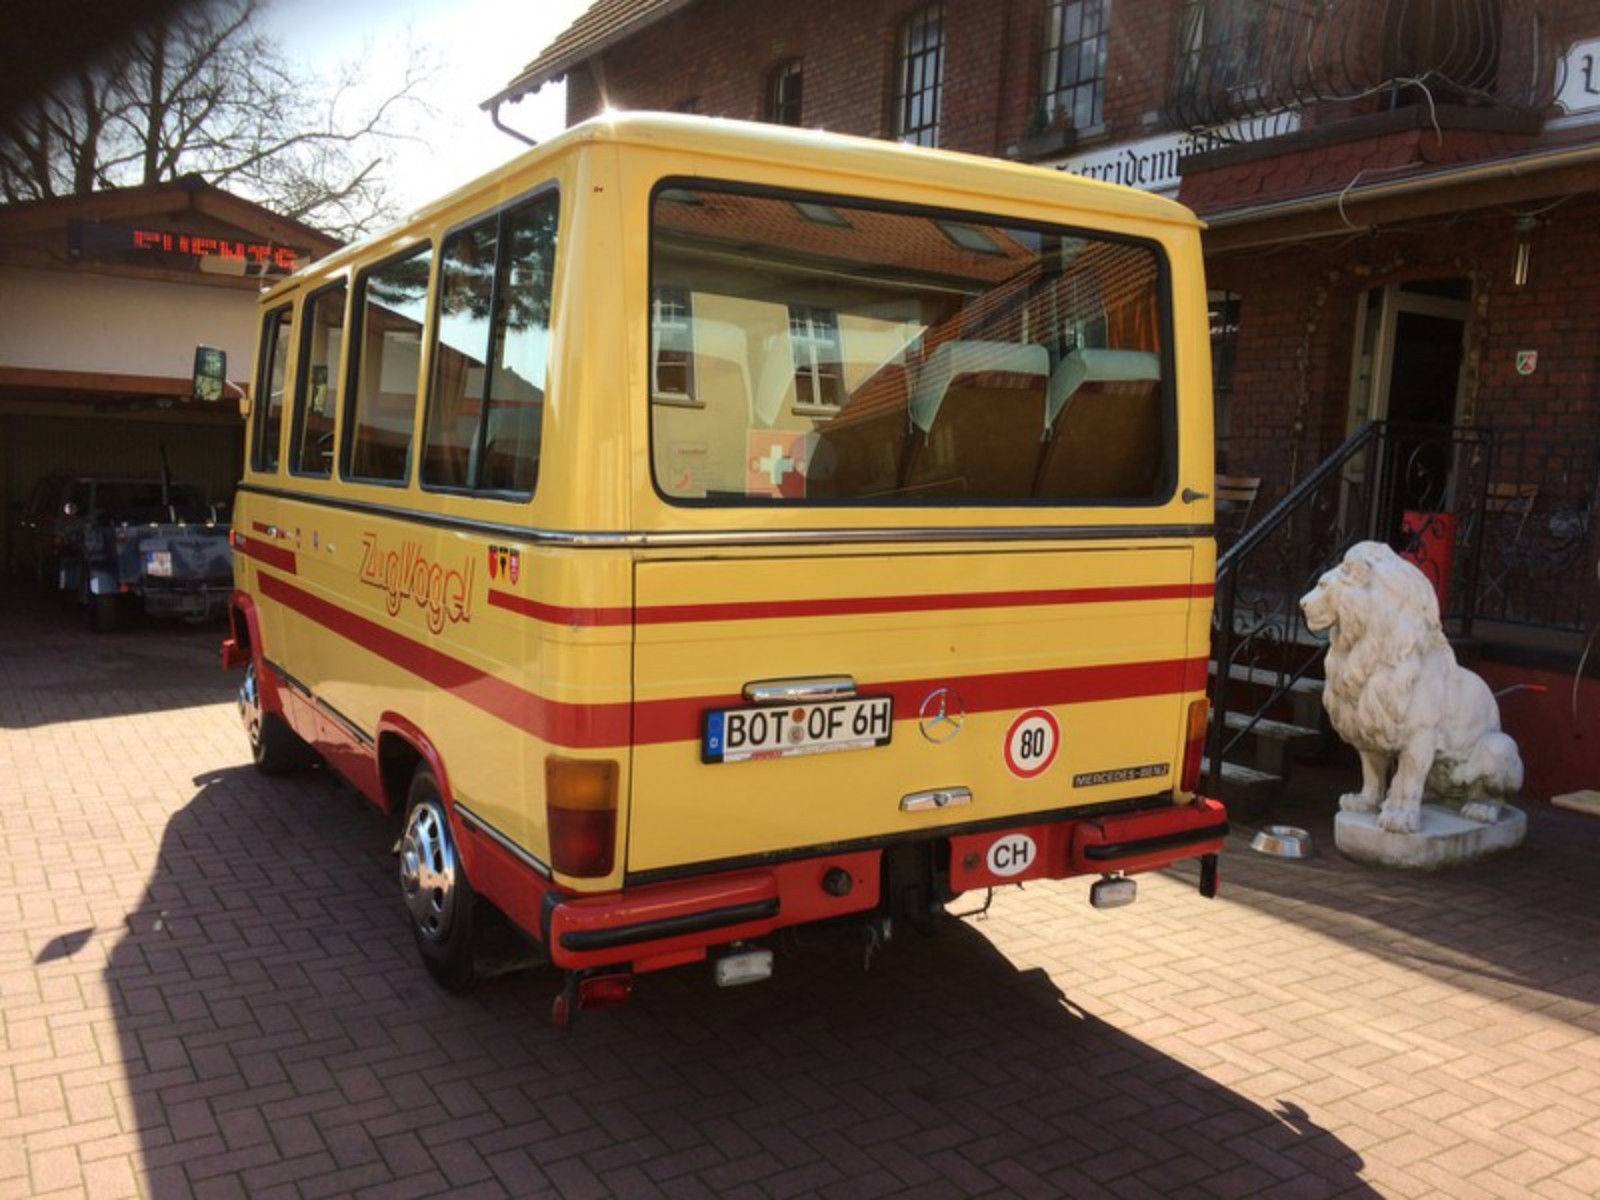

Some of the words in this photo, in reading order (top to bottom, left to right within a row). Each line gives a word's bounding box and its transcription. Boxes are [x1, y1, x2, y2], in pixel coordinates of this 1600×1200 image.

[727, 710, 789, 748] BOT
[807, 705, 846, 739] OF
[852, 701, 888, 736] 6H
[1020, 727, 1045, 759] 80
[993, 841, 1028, 868] CH
